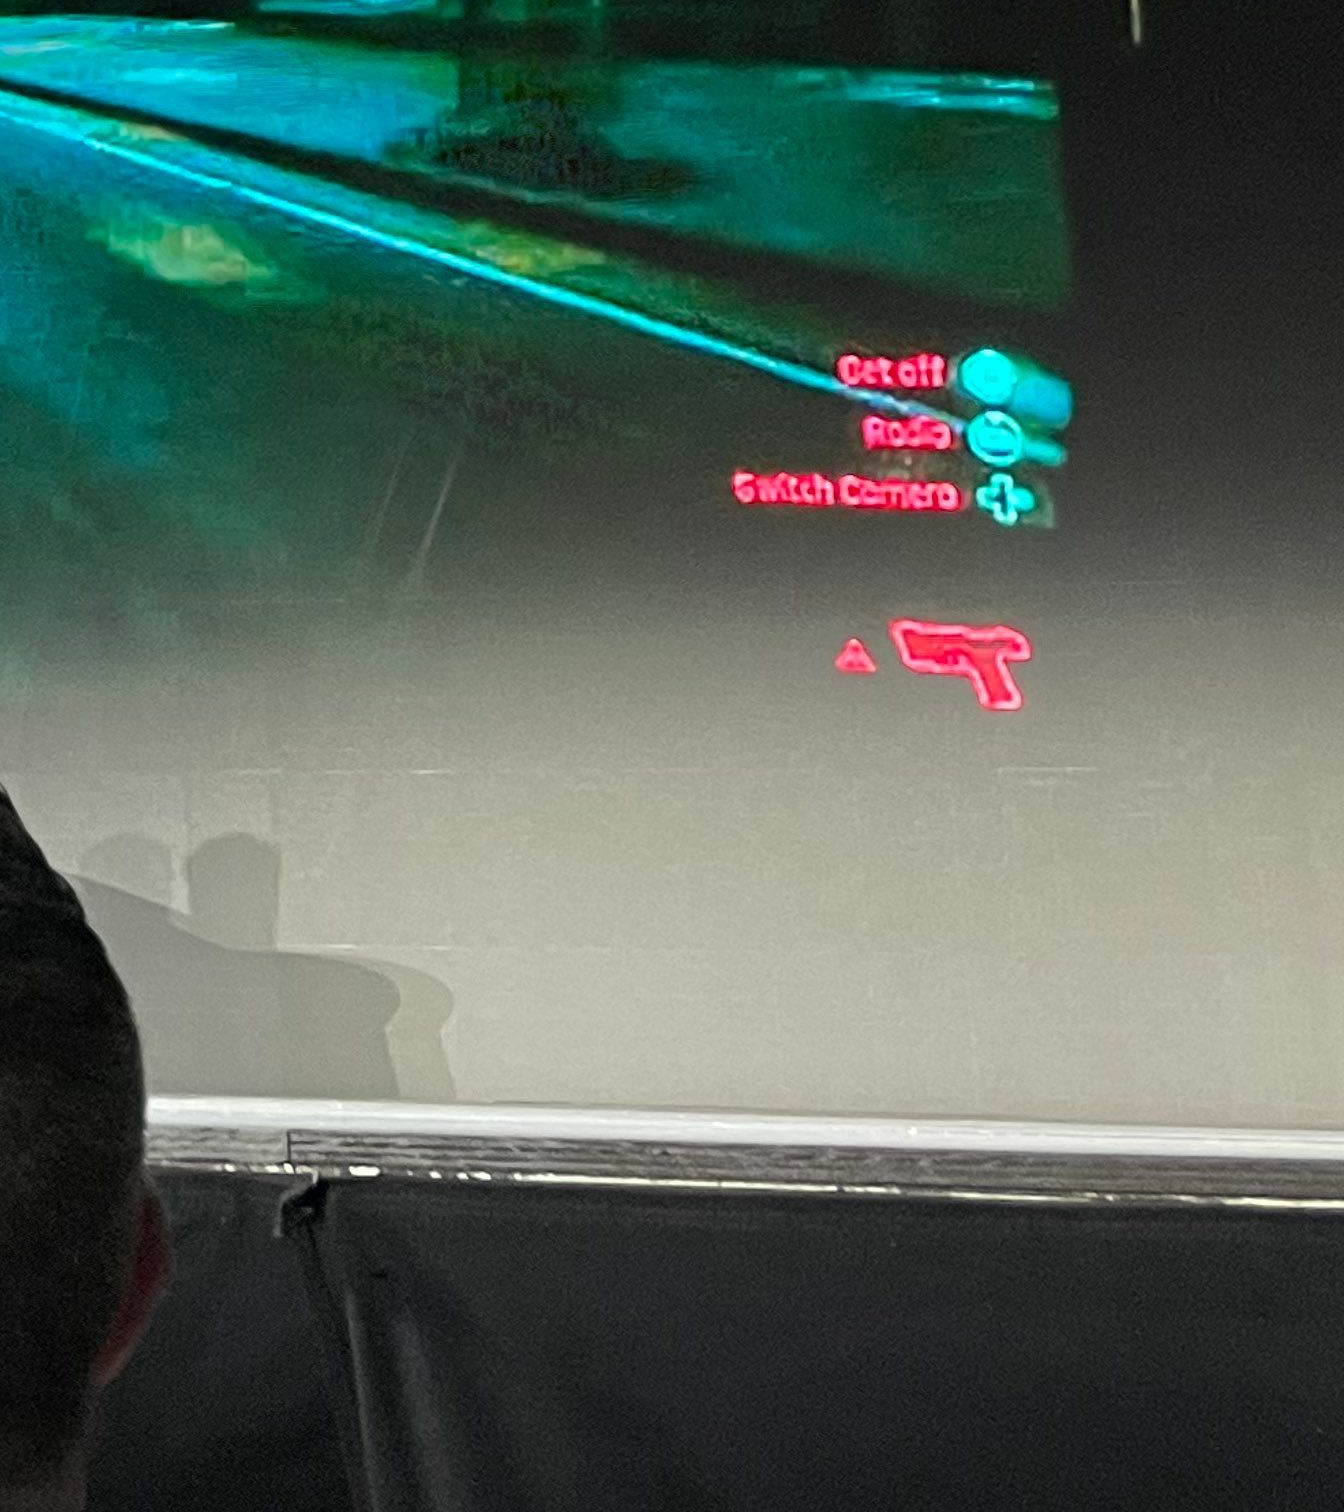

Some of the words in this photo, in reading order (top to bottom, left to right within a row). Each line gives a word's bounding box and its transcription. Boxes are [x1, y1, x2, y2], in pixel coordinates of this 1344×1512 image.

[897, 352, 947, 388] off
[733, 471, 835, 506] Switch
[836, 474, 962, 511] Camera
